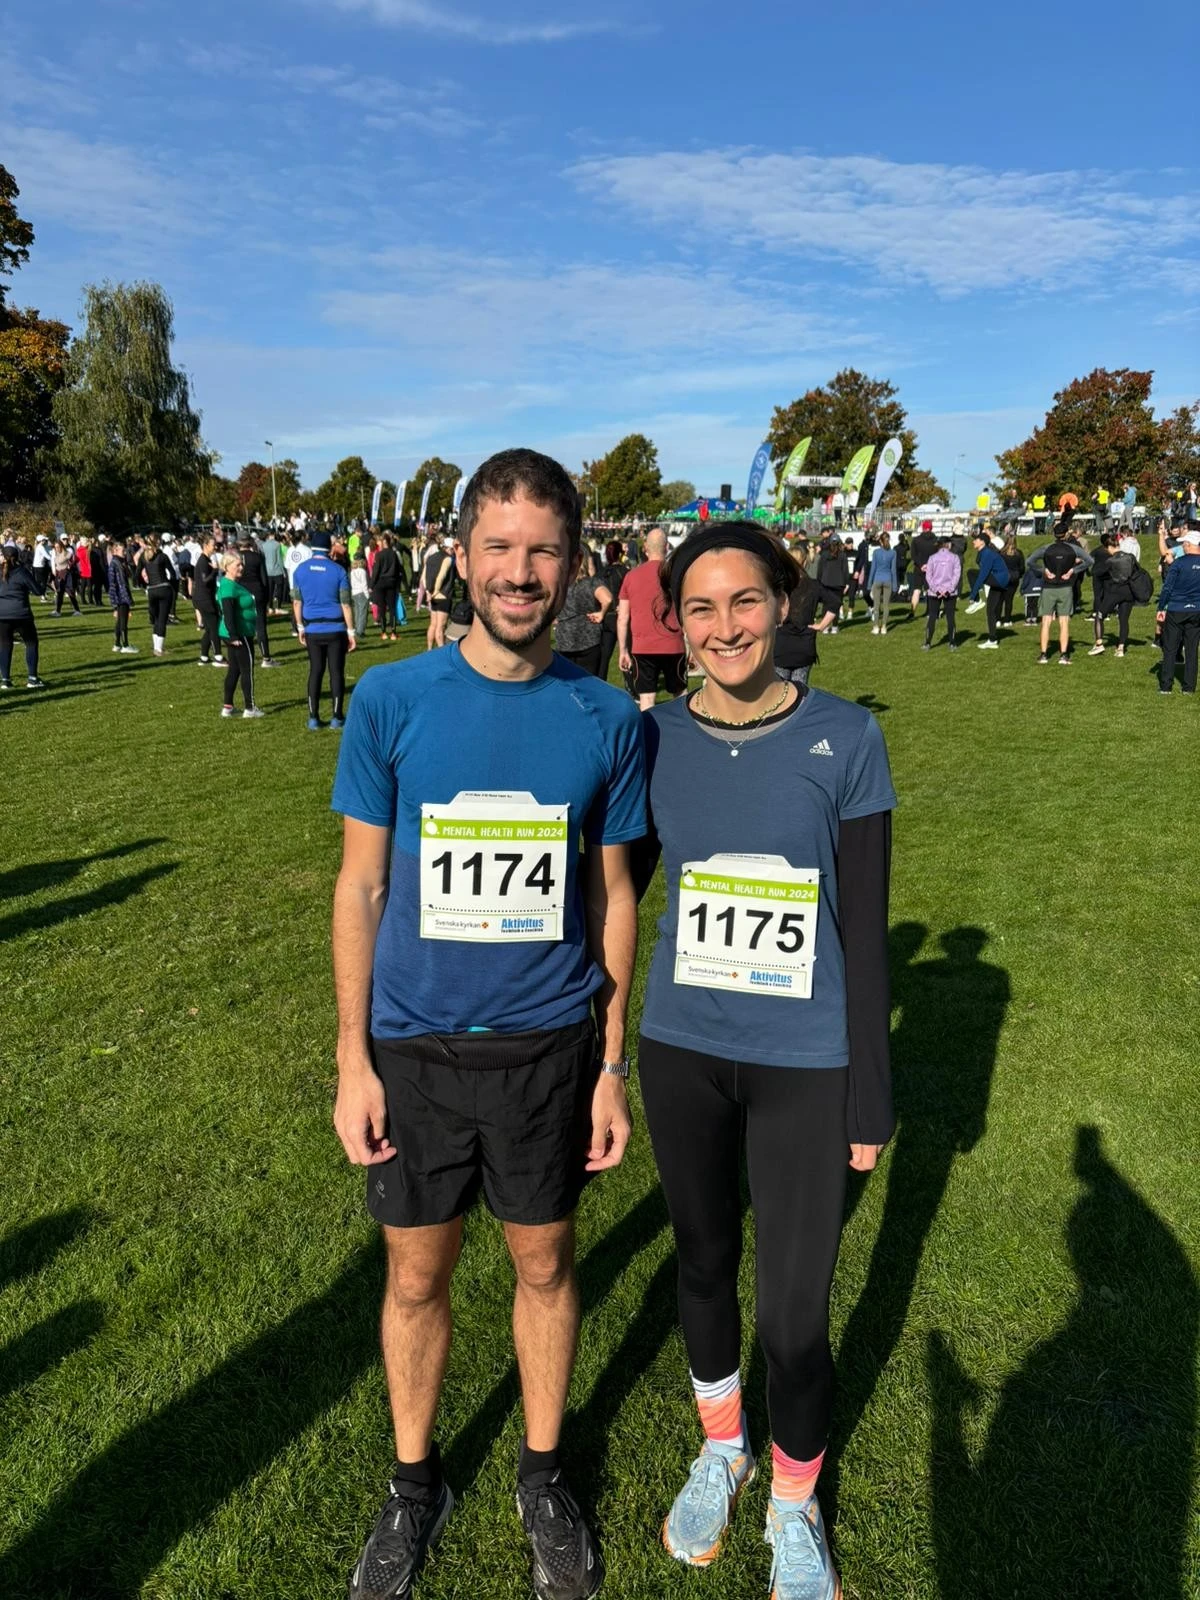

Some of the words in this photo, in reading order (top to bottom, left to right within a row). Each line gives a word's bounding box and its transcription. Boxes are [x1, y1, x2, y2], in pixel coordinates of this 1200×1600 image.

[809, 748, 833, 756] adidas
[442, 826, 477, 837] MENTAL
[480, 827, 513, 838] HEALTH
[516, 828, 535, 838] RUN
[536, 827, 564, 838] 2024
[432, 851, 556, 896] 1174
[699, 879, 731, 891] MENTAL
[734, 884, 765, 896] HEALTH
[768, 887, 787, 898] RUN
[788, 890, 815, 900] 2024
[501, 918, 544, 929] Aktivitus
[689, 902, 805, 954] 1175
[750, 970, 793, 984] Aktivitus
